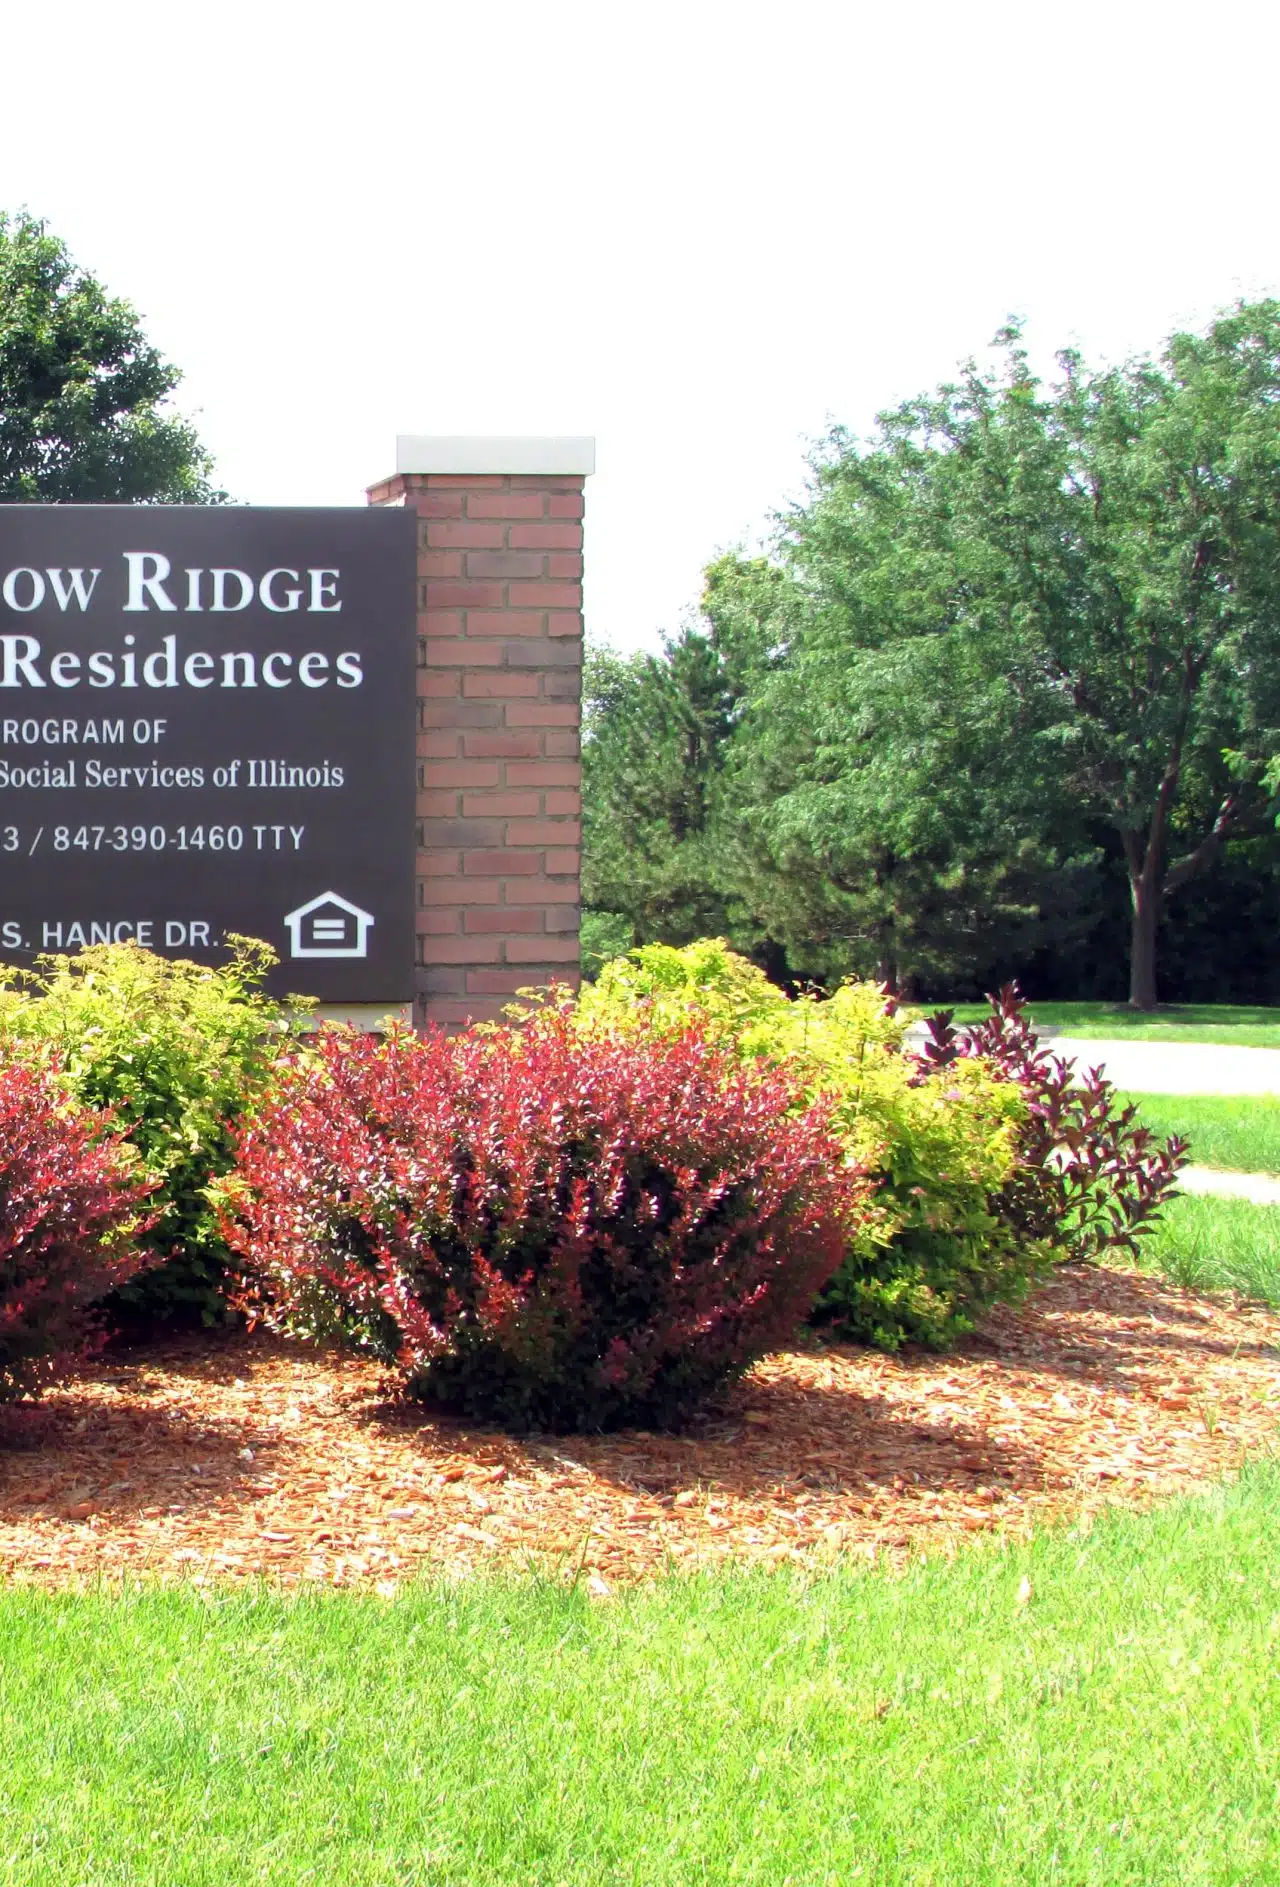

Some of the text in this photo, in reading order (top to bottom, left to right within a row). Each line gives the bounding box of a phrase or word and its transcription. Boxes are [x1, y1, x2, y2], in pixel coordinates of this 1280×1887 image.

[121, 551, 343, 613] RIDGE
[132, 718, 168, 744] OF
[85, 759, 205, 788] Services
[212, 759, 242, 788] of
[247, 759, 345, 788] Illinois
[28, 827, 44, 856] /
[53, 825, 244, 851] 847-390-1460
[252, 825, 306, 850] TTY
[1, 921, 31, 948] S.
[42, 921, 153, 948] HANCE
[165, 921, 219, 947] DR.
